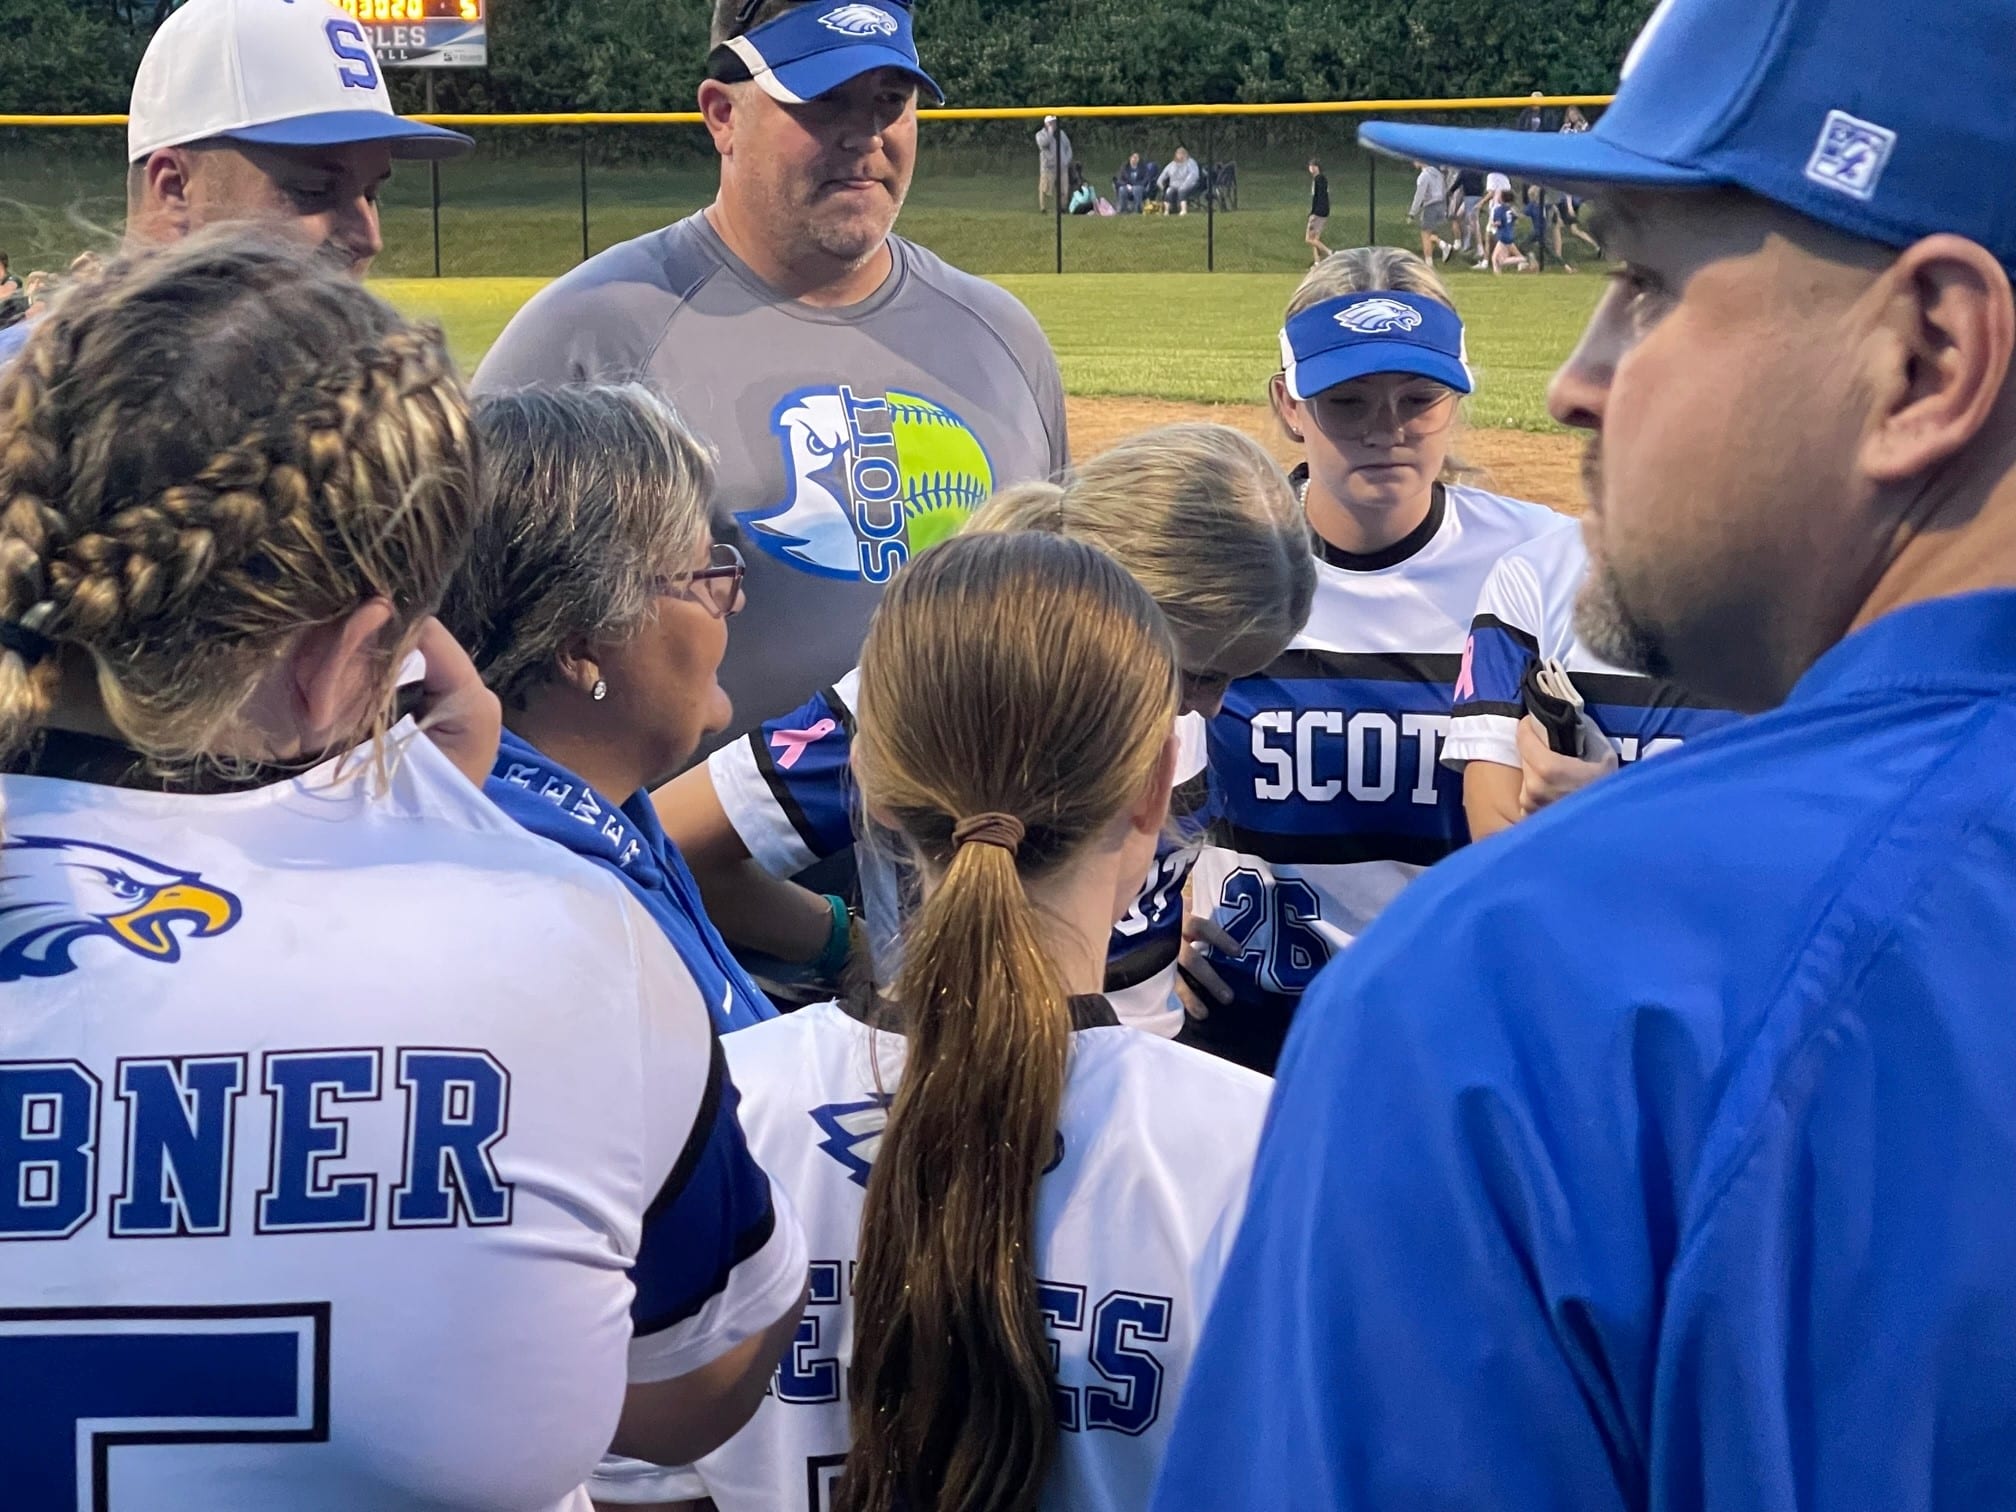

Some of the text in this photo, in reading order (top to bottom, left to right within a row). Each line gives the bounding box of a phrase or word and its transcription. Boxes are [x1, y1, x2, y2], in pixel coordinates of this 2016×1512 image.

[325, 18, 378, 90] S
[840, 385, 909, 584] SCOTT
[1209, 866, 1332, 994] 26
[0, 1045, 514, 1242] BNER
